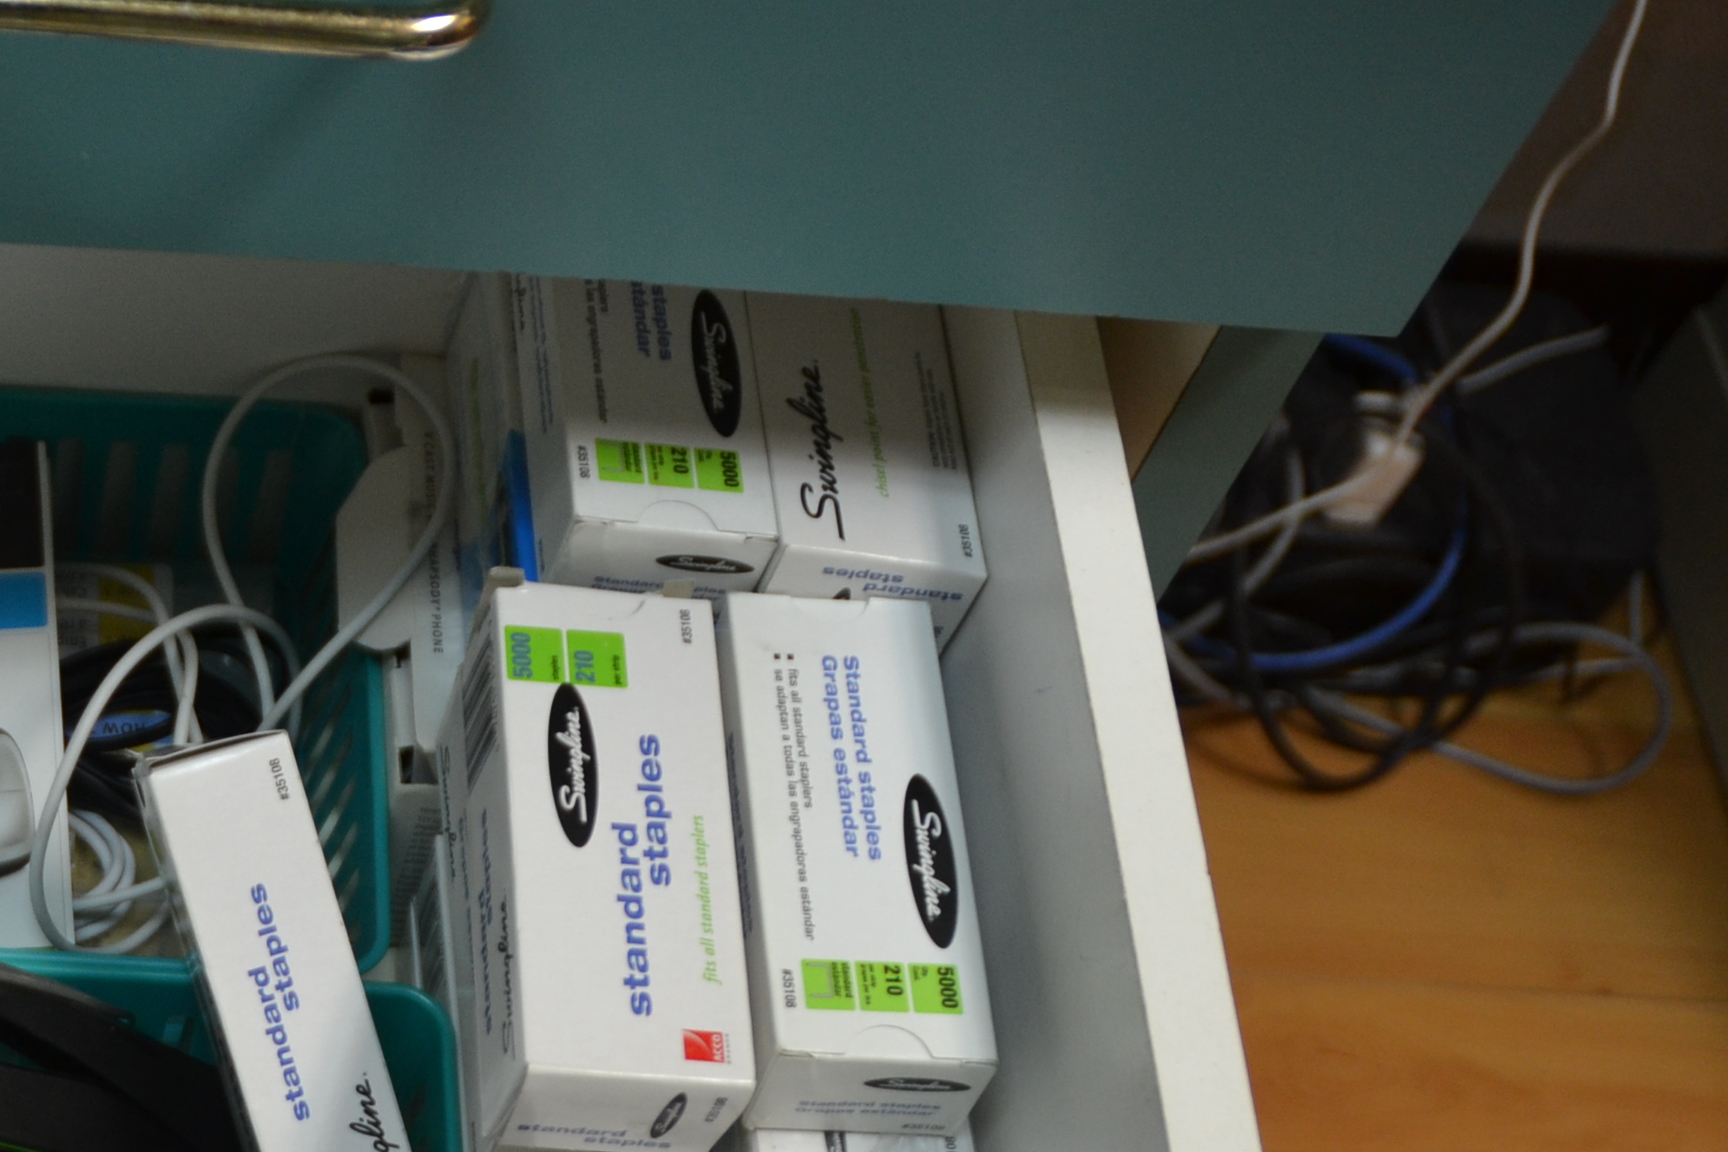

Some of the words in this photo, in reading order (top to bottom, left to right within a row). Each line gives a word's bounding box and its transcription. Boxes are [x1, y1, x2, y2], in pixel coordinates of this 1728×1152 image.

[577, 445, 590, 479] #35108
[672, 447, 689, 474] 210
[721, 451, 740, 488] 5000
[786, 362, 845, 541] Swingline
[873, 463, 890, 498] chisel
[959, 524, 972, 558] #35108
[823, 565, 905, 584] staples
[863, 583, 964, 602] standard
[432, 613, 444, 654] PHONE
[679, 609, 693, 645] #35108
[510, 632, 533, 679] 5000
[574, 650, 595, 683] 210
[774, 669, 783, 681] se
[788, 668, 799, 687] fits
[791, 688, 802, 703] all
[793, 706, 809, 759] standard
[556, 707, 591, 824] Swingline
[784, 745, 795, 777] todas
[821, 654, 844, 741] Grapas
[833, 746, 859, 858] estándar
[843, 654, 873, 764] Standard
[859, 770, 882, 861] staples
[268, 757, 290, 802] #35108
[799, 761, 813, 809] staplers
[638, 734, 673, 886] staples
[690, 815, 709, 867] staplers
[788, 801, 808, 883] engrapadoras
[911, 799, 951, 922] Swingline
[612, 822, 652, 1017] standard
[694, 871, 714, 934] standard
[251, 883, 300, 1011] staples
[700, 936, 716, 957] all
[498, 901, 516, 1060] Swingline
[703, 962, 723, 986] fits
[782, 969, 797, 1008] #35108
[842, 962, 854, 998] standard
[883, 964, 904, 996] 210
[937, 966, 959, 1009] 5000
[247, 965, 310, 1121] standard
[712, 1034, 722, 1062] ACCO
[517, 1123, 627, 1138] standard
[583, 1136, 671, 1149] staples
